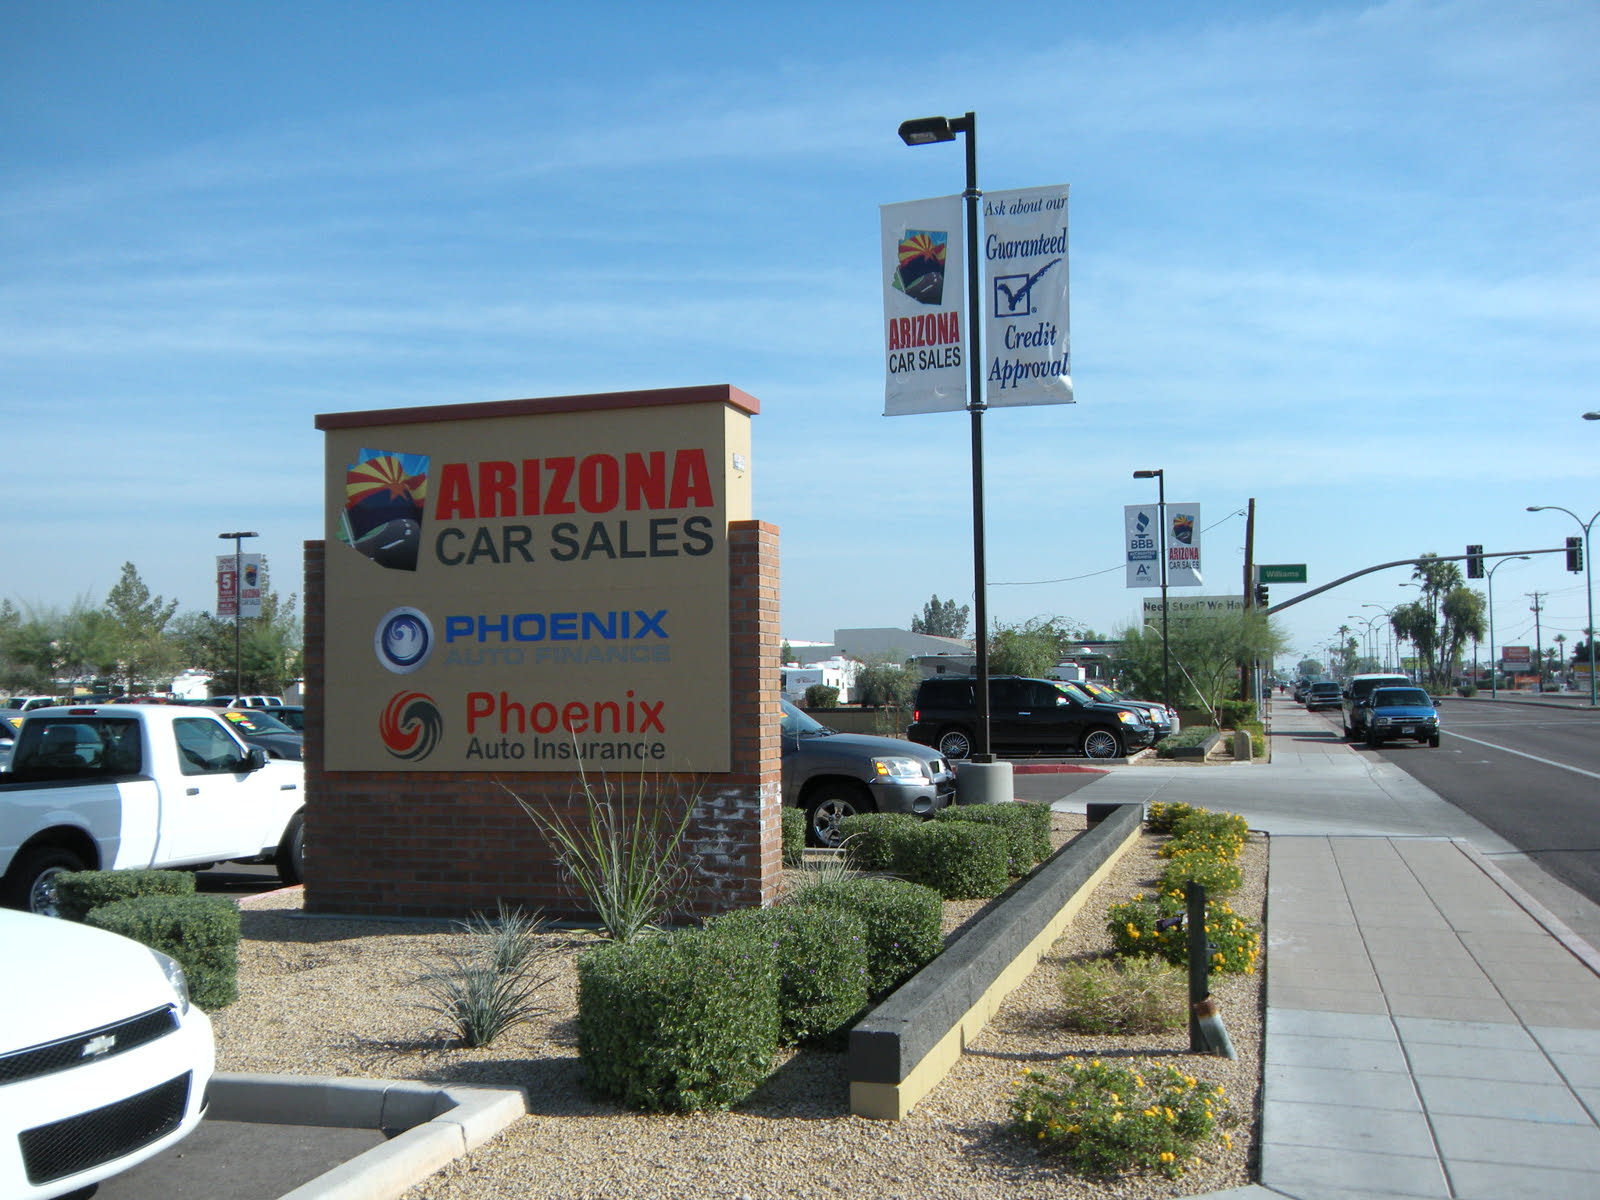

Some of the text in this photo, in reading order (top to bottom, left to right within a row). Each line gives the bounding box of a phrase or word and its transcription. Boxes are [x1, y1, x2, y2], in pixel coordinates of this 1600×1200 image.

[985, 197, 1068, 216] Ask about our
[986, 227, 1067, 260] Guaranteed
[889, 311, 960, 350] ARIZONA
[1004, 321, 1057, 350] Credit
[889, 346, 961, 374] CAR SALES
[988, 352, 1068, 389] Approval
[435, 448, 715, 520] ARIZONA
[435, 515, 715, 566] CAR SALES
[1131, 539, 1154, 549] BBB
[1169, 547, 1199, 560] ARIZONA
[1169, 561, 1181, 569] CAR
[1136, 563, 1151, 575] A+
[1266, 570, 1300, 578] Williams
[222, 573, 232, 590] 5
[1207, 601, 1224, 610] We
[445, 610, 669, 643] PHOENIX
[444, 645, 671, 666] AUTO FINANCE
[466, 690, 666, 735] Phoenix
[466, 737, 666, 760] Auto Insurance
